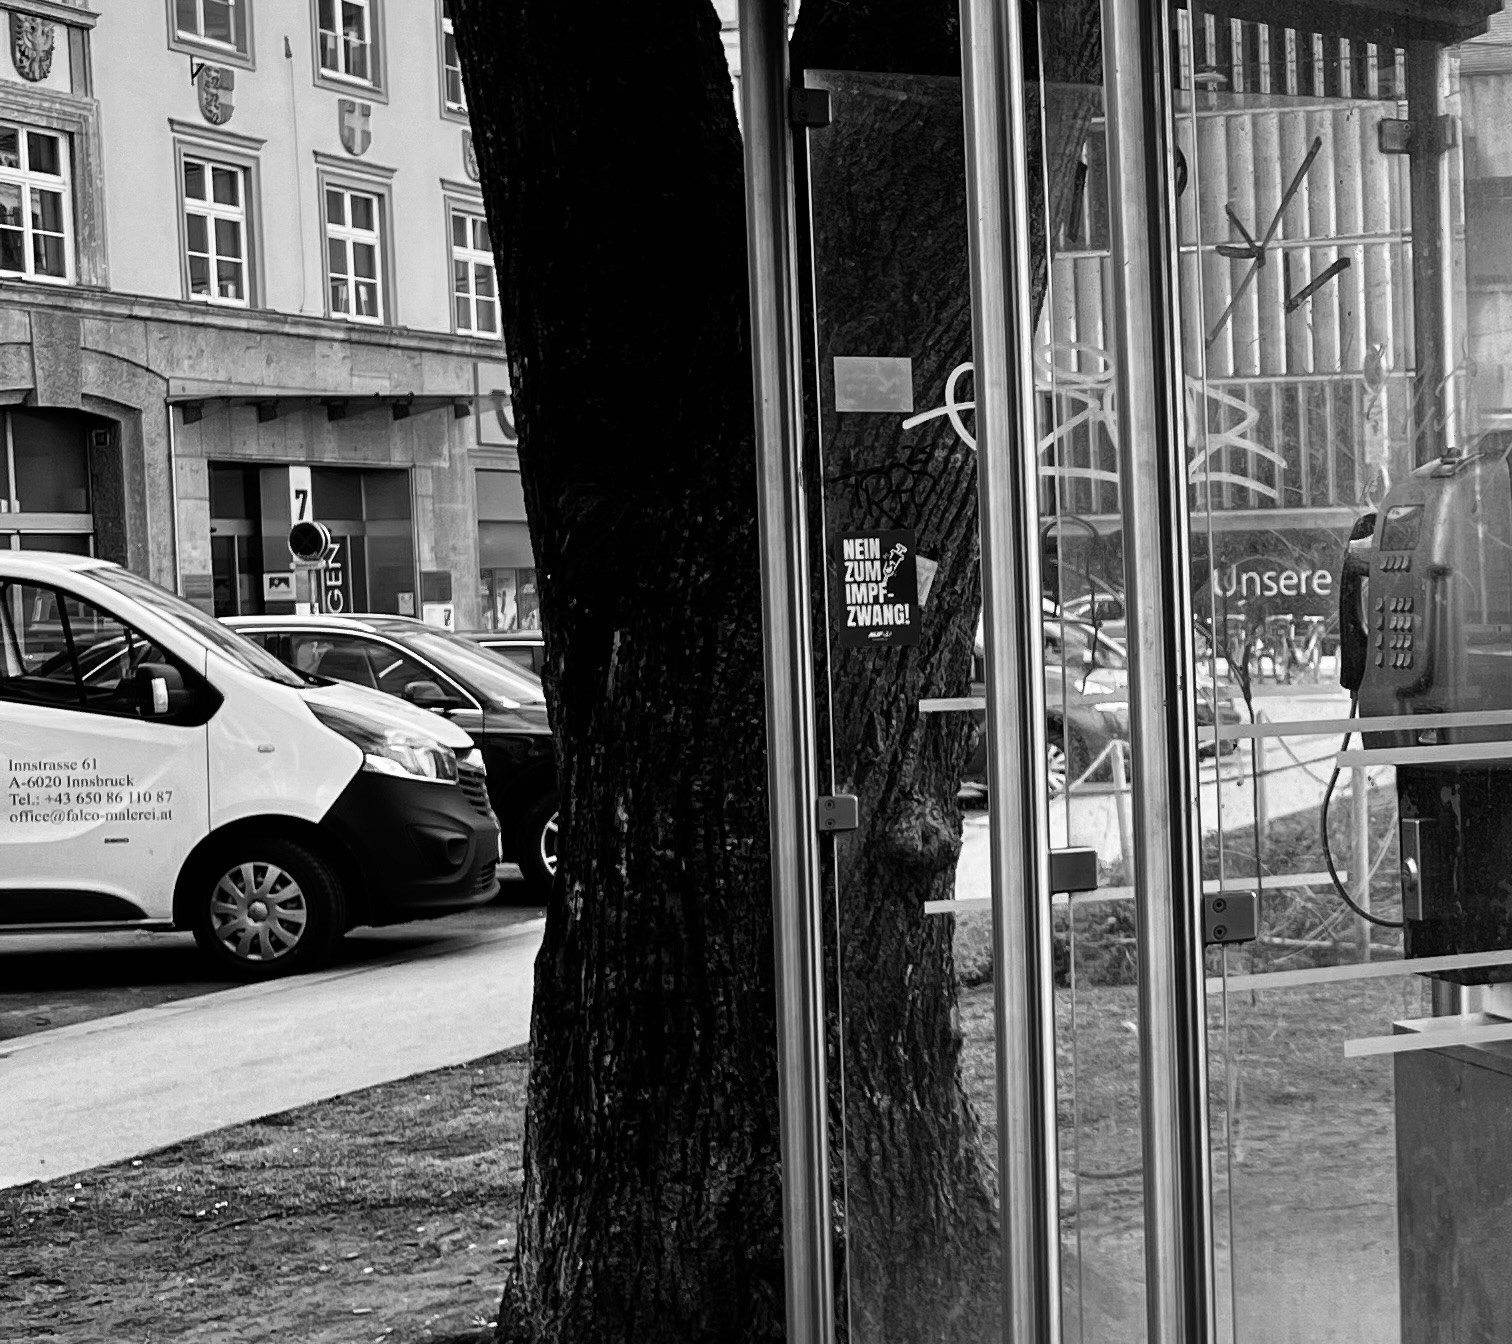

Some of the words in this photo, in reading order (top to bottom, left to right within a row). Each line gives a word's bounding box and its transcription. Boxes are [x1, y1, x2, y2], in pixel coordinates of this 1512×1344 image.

[295, 489, 308, 520] 7
[843, 538, 881, 560] NEIN
[844, 560, 882, 582] ZUM
[1213, 564, 1333, 597] Unsere
[845, 582, 894, 605] IMPF-
[847, 604, 910, 627] ZWANG!
[9, 759, 78, 772] Innstrasse
[82, 757, 97, 770] 61
[8, 776, 62, 789] A-6020
[66, 774, 134, 787] Innsbruck
[8, 792, 40, 806] Tel.:
[44, 792, 71, 805] +43
[76, 791, 102, 805] 650
[106, 791, 123, 804] 86
[129, 790, 152, 804] 110
[156, 790, 173, 803] 87
[9, 808, 173, 825] office@falco-malerei.at
